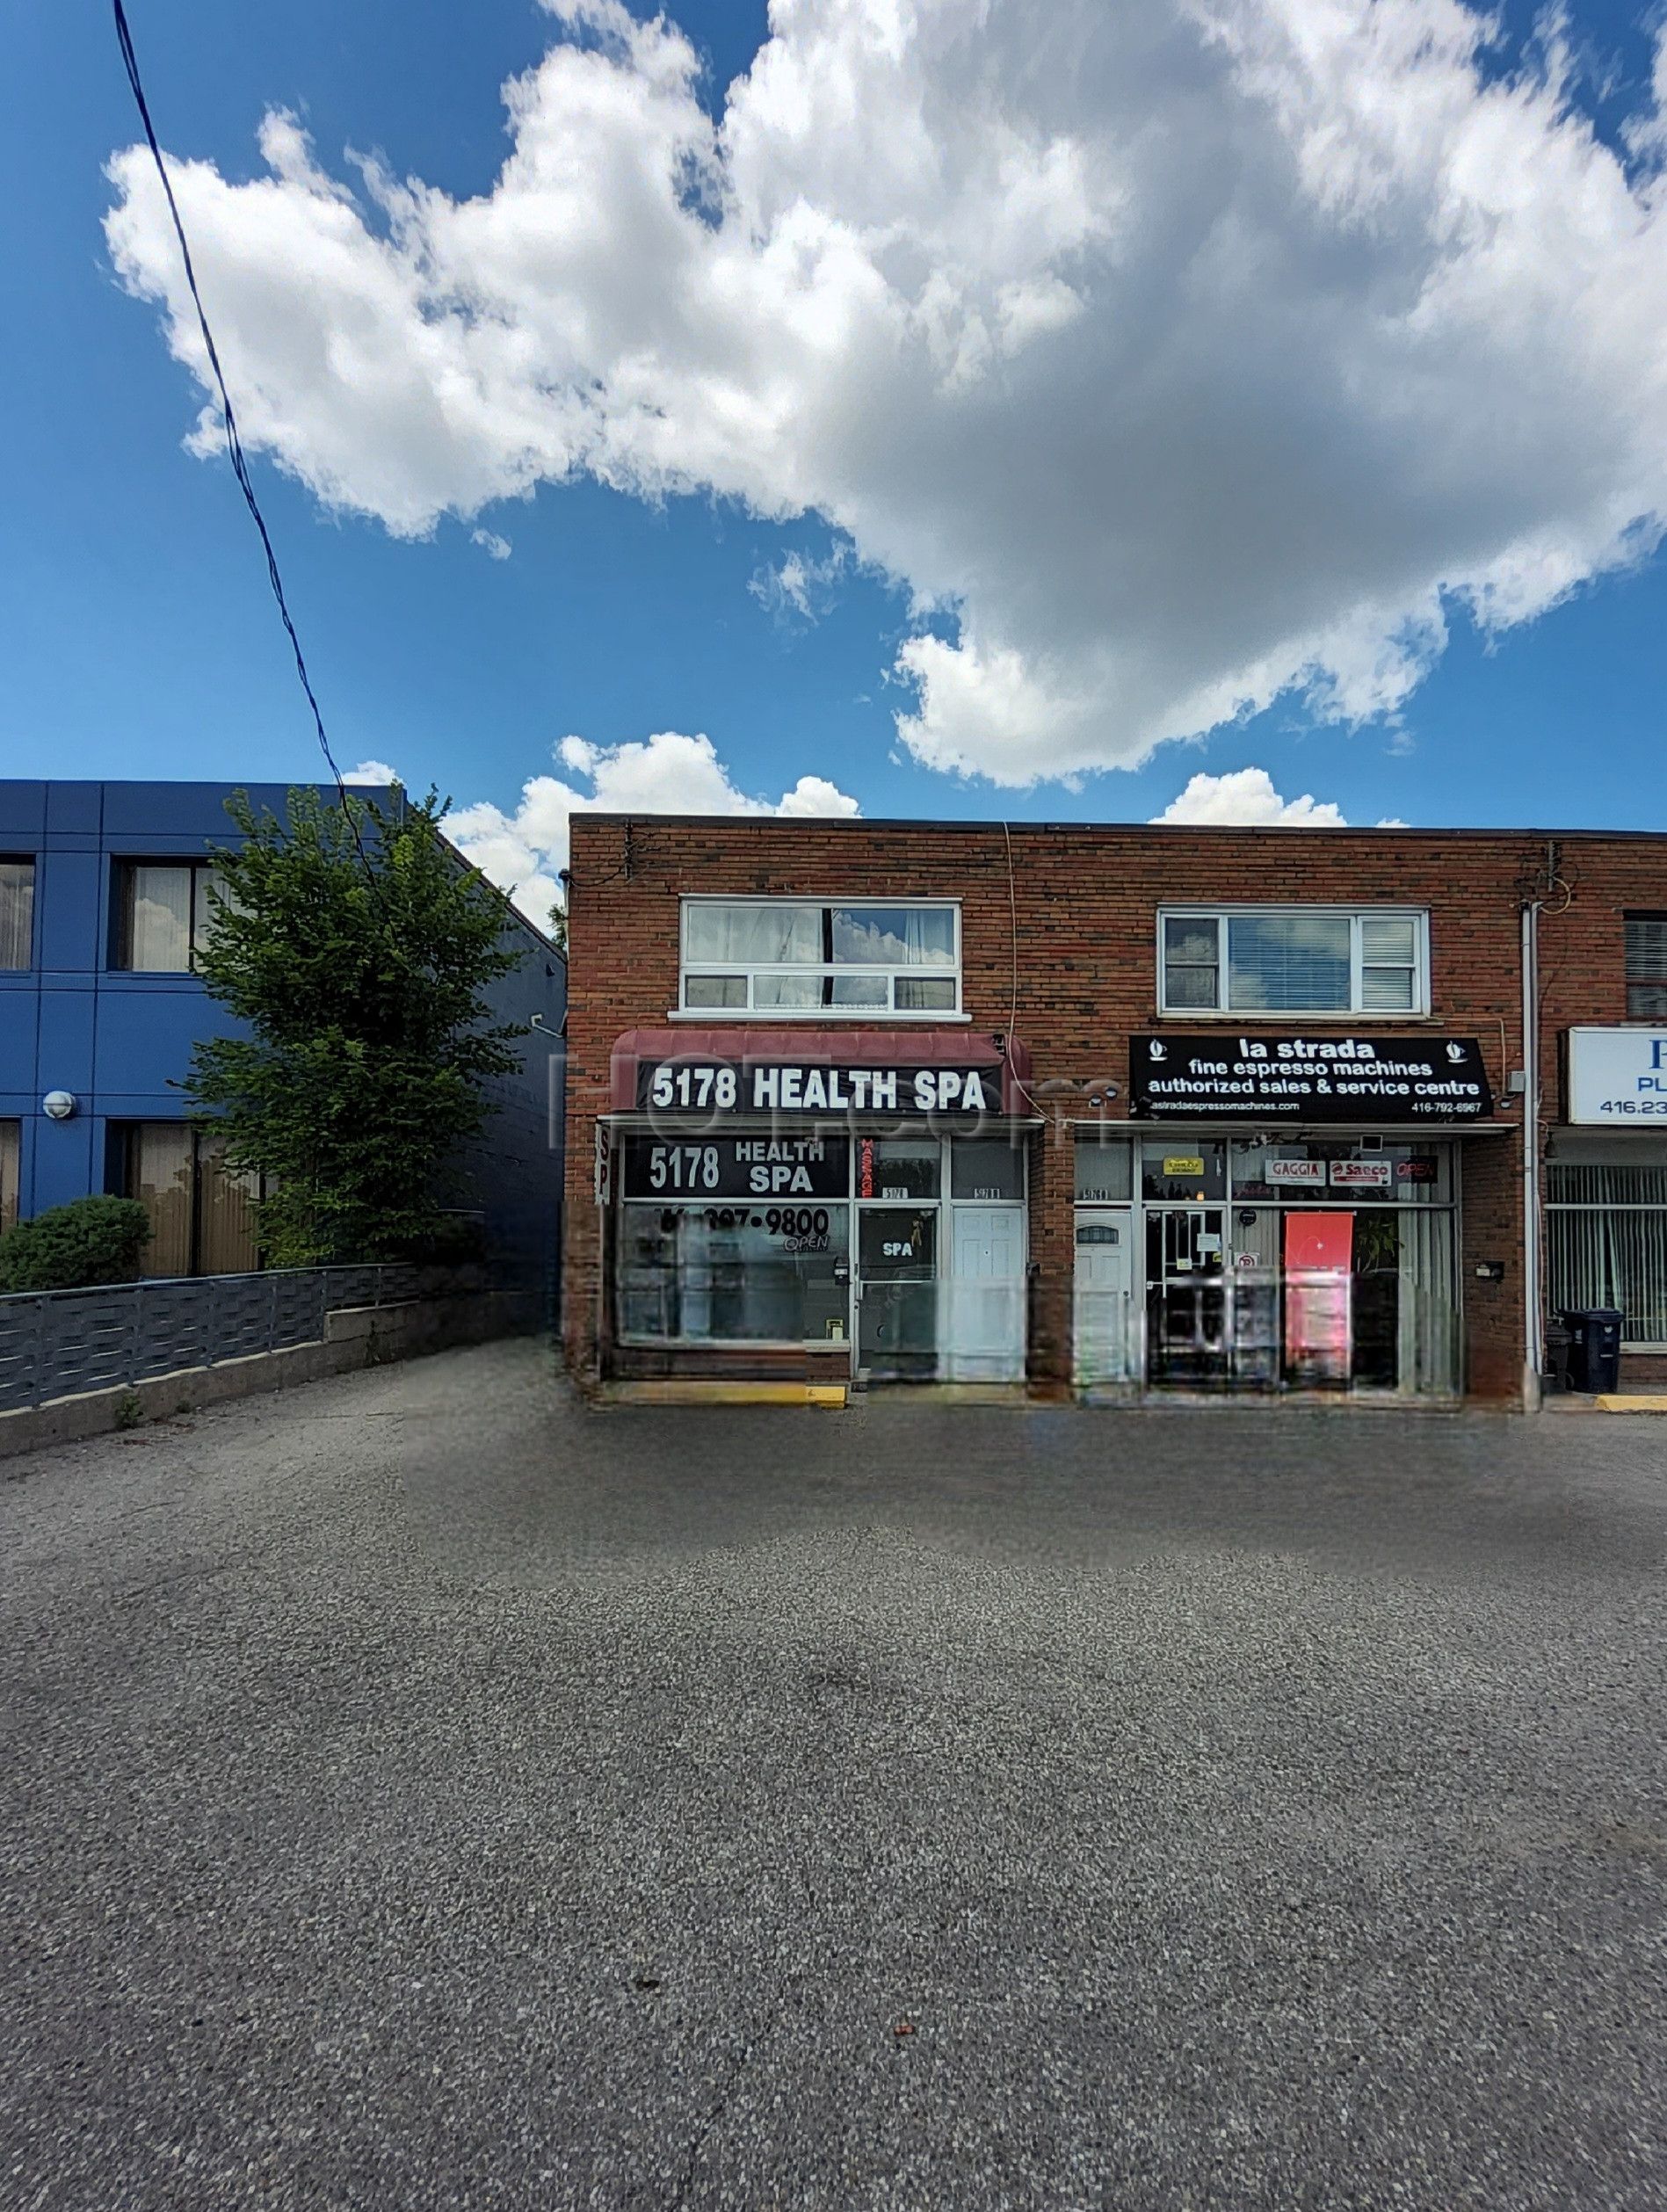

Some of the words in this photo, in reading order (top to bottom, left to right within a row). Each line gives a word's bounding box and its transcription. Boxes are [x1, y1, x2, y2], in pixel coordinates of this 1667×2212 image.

[1239, 1038, 1267, 1058] la
[1277, 1039, 1375, 1059] strada
[1188, 1058, 1228, 1075] fine
[1233, 1062, 1329, 1078] espresso
[1333, 1060, 1433, 1077] machines
[652, 1067, 736, 1108] 5178
[753, 1068, 896, 1109] HEALTH
[913, 1070, 987, 1111] SPA
[1148, 1077, 1255, 1093] authorized
[1259, 1078, 1312, 1094] sales
[1316, 1078, 1332, 1095] &
[1336, 1079, 1410, 1095] service
[1414, 1080, 1480, 1096] centre
[1150, 1100, 1300, 1112] astradaespressomachines.com
[736, 1142, 824, 1162] HEALTH
[598, 1129, 610, 1205] SP
[649, 1146, 719, 1188] 5178
[1272, 1162, 1319, 1176] GAGGIA
[1345, 1164, 1388, 1176] Saeco
[750, 1165, 814, 1193] SPA
[784, 1235, 829, 1251] OPEN
[881, 1242, 913, 1257] SPA
